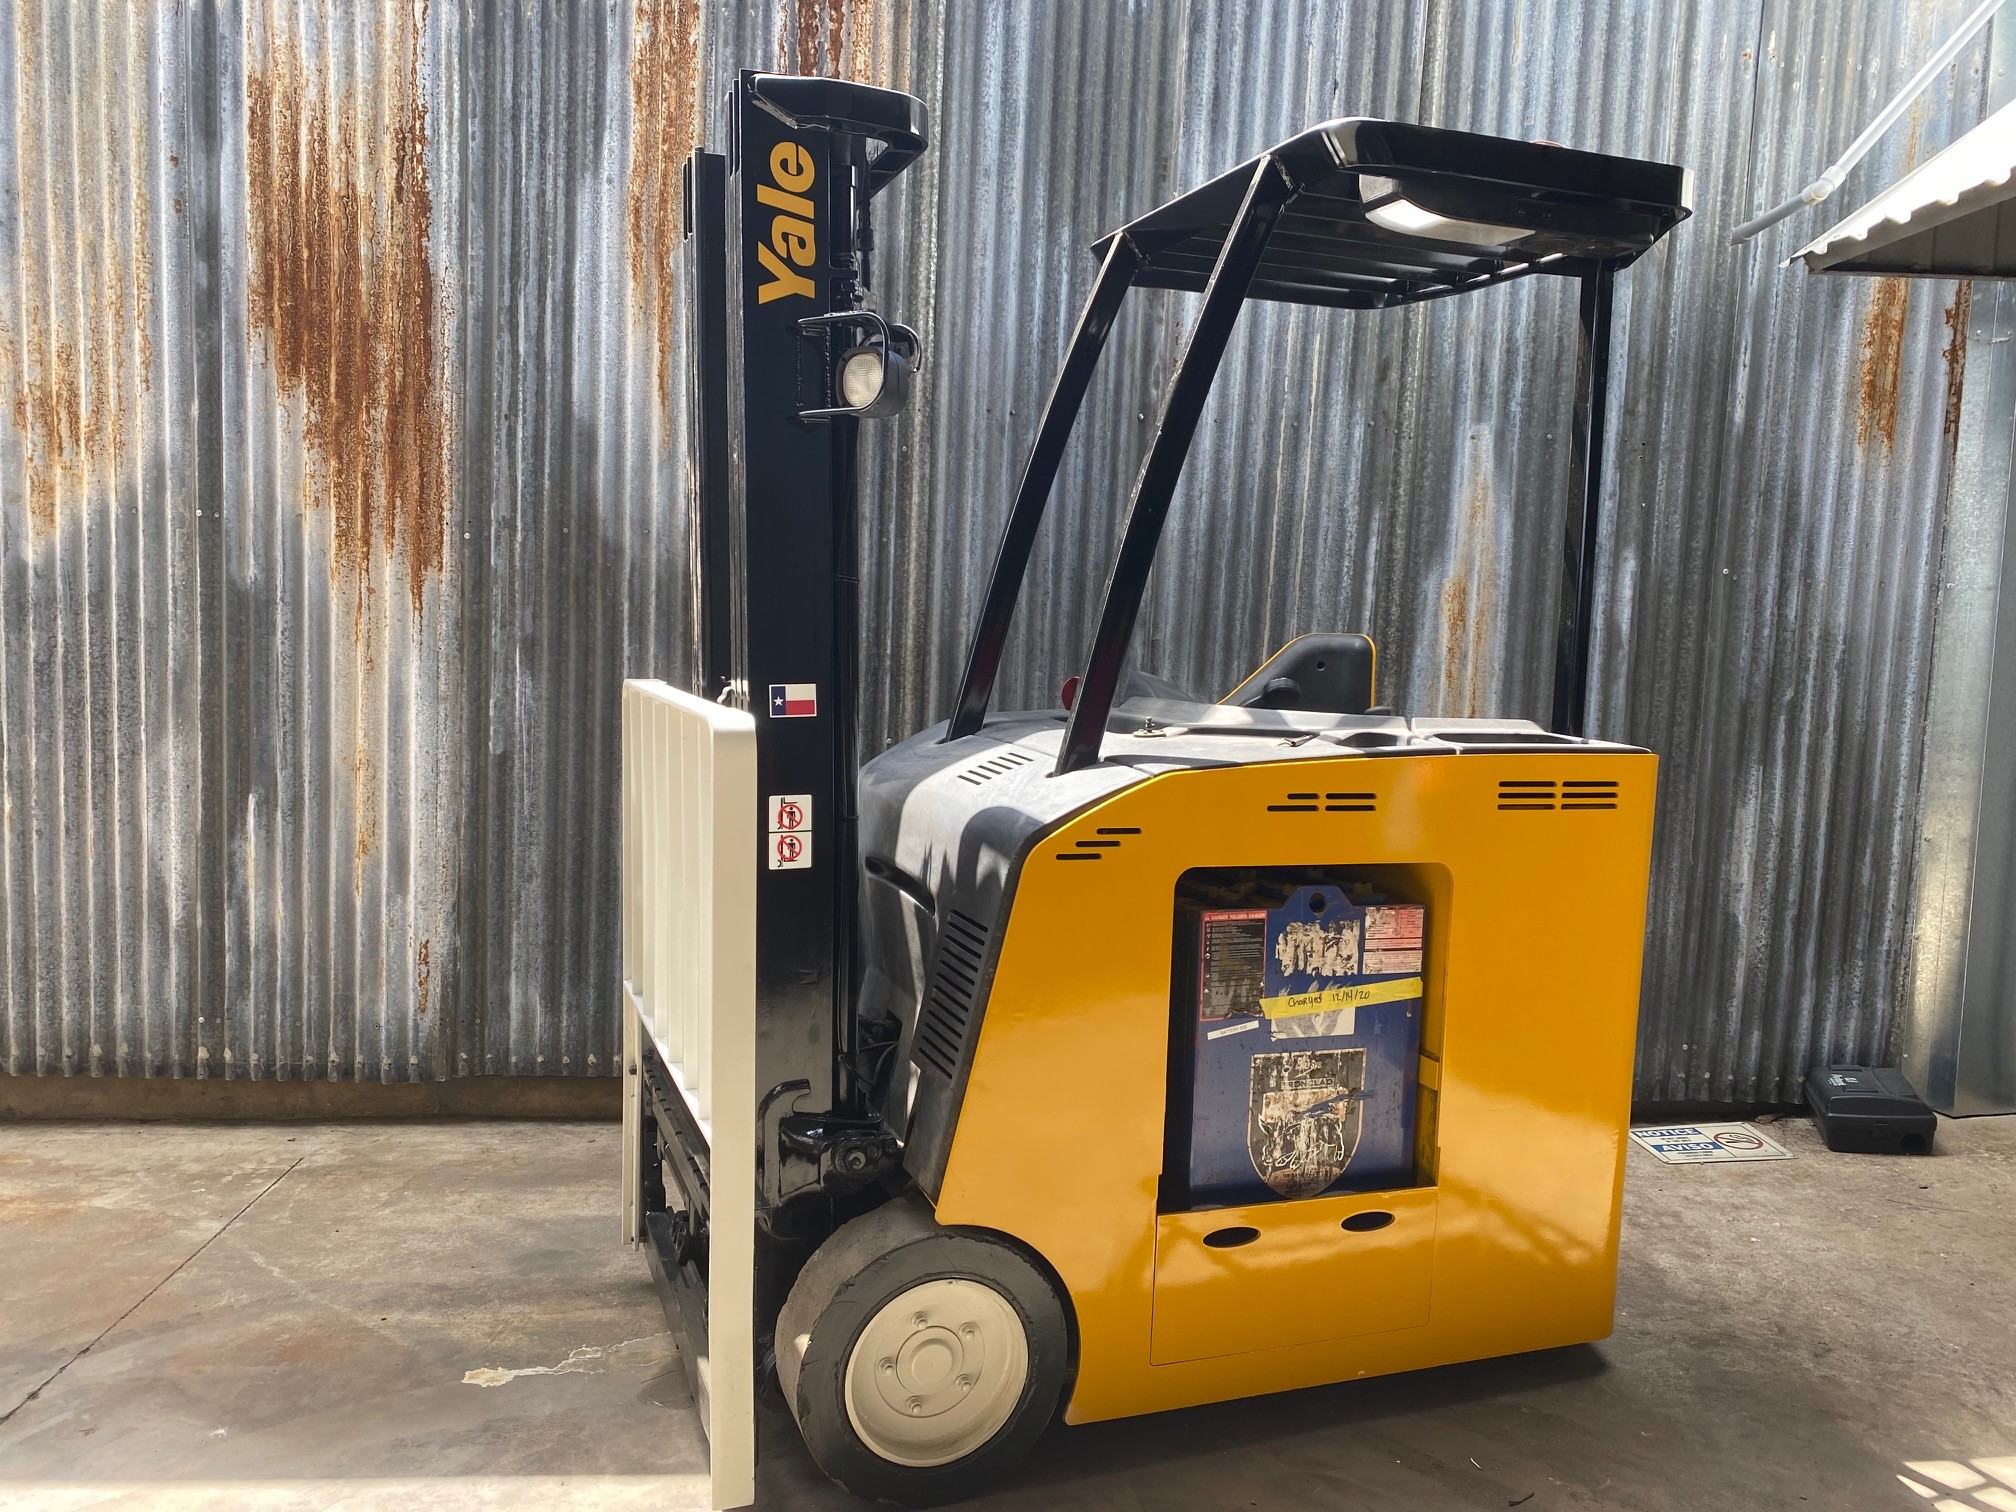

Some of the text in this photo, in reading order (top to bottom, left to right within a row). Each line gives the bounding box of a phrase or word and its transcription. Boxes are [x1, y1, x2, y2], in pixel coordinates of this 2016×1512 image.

[757, 141, 816, 304] Yale
[1332, 989, 1371, 1003] 12/14/20
[1220, 1026, 1240, 1036] BATTERY
[1634, 1128, 1699, 1138] NOTICE
[1662, 1142, 1714, 1151] AVISO
